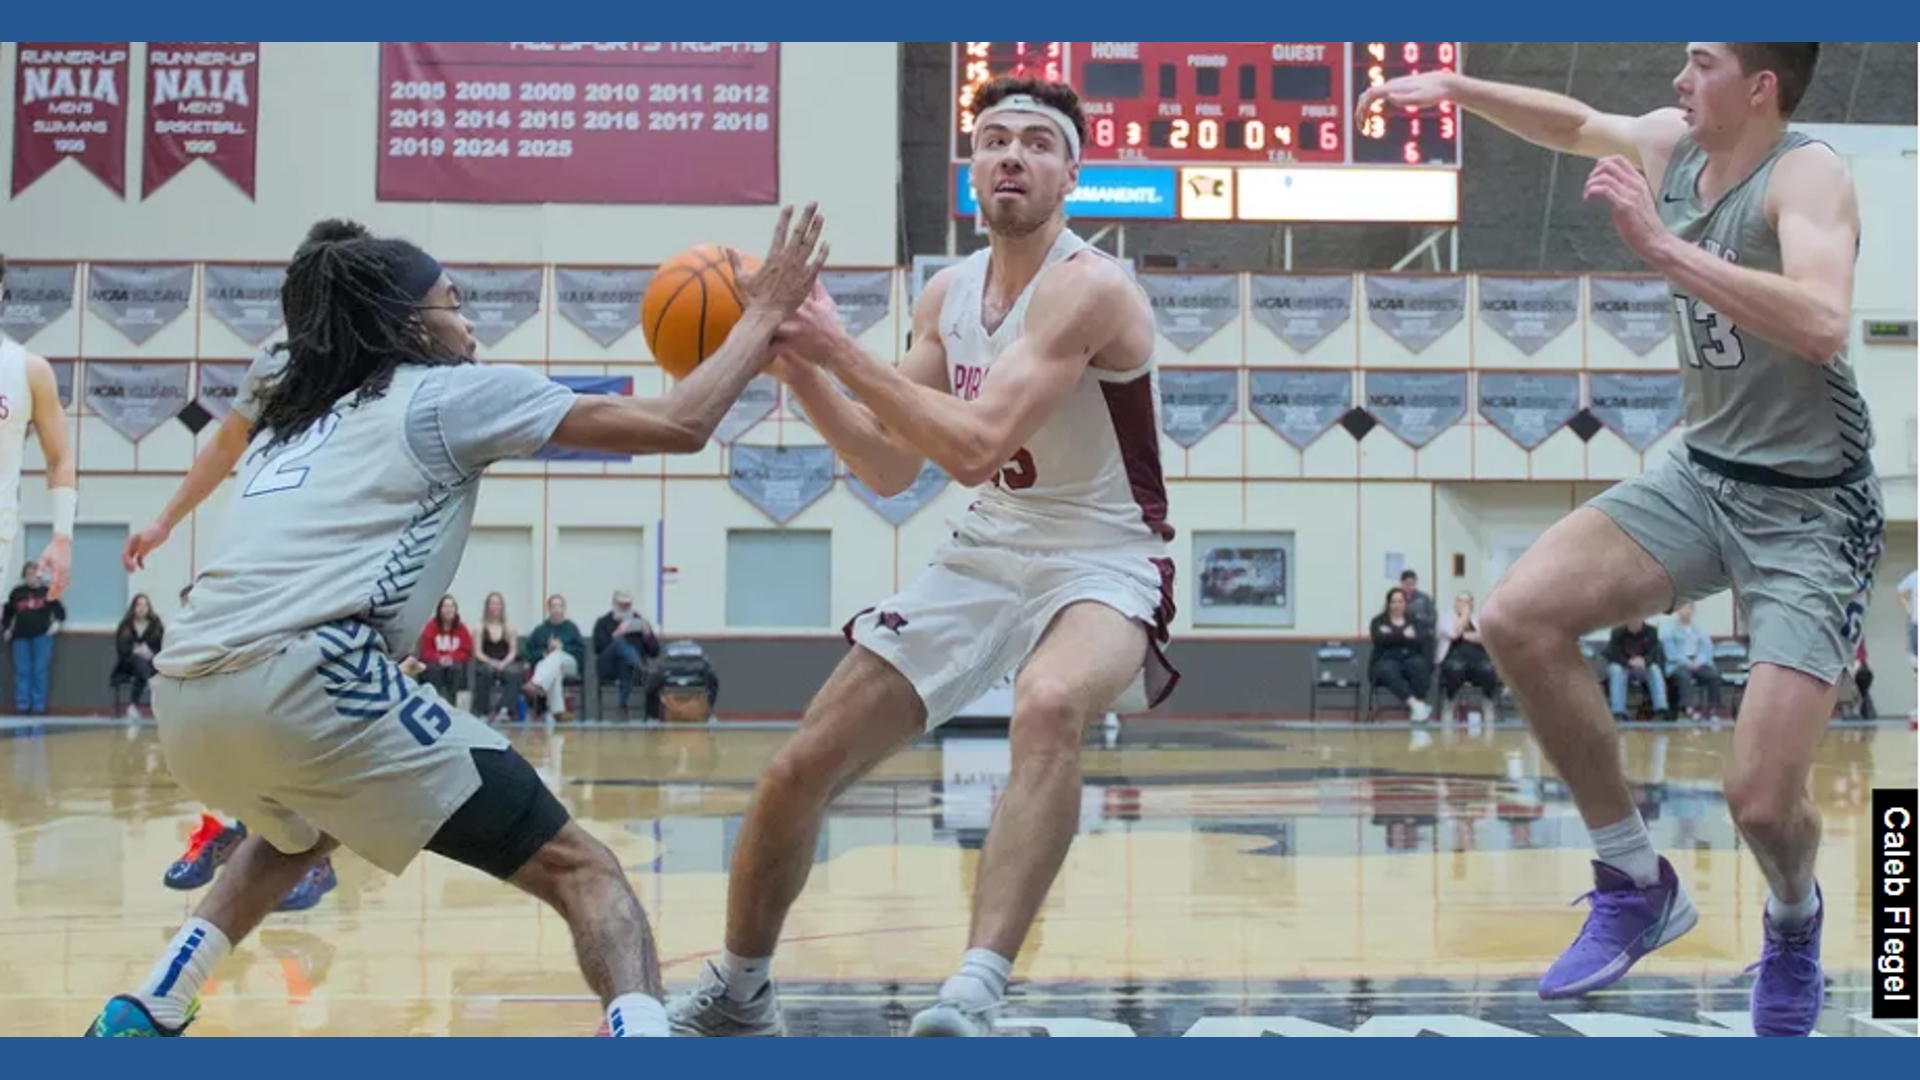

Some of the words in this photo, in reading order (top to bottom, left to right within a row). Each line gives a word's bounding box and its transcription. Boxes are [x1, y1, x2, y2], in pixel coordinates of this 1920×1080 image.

[1091, 42, 1139, 59] HOME
[23, 67, 119, 105] NAIA
[153, 69, 249, 107] NAIA
[390, 82, 446, 100] 2005
[455, 82, 511, 101] 2008
[519, 82, 576, 101] 2009
[585, 84, 640, 102] 2010
[649, 84, 702, 102] 2011
[713, 85, 769, 103] 2012
[389, 110, 446, 129] 2013
[455, 110, 511, 129] 2014
[519, 111, 576, 130] 2015
[584, 111, 640, 130] 2016
[649, 112, 703, 131] 2017
[713, 112, 769, 132] 2018
[389, 138, 446, 157] 2019
[453, 138, 509, 157] 2024
[517, 140, 573, 157] 2025
[1673, 293, 1746, 370] 13
